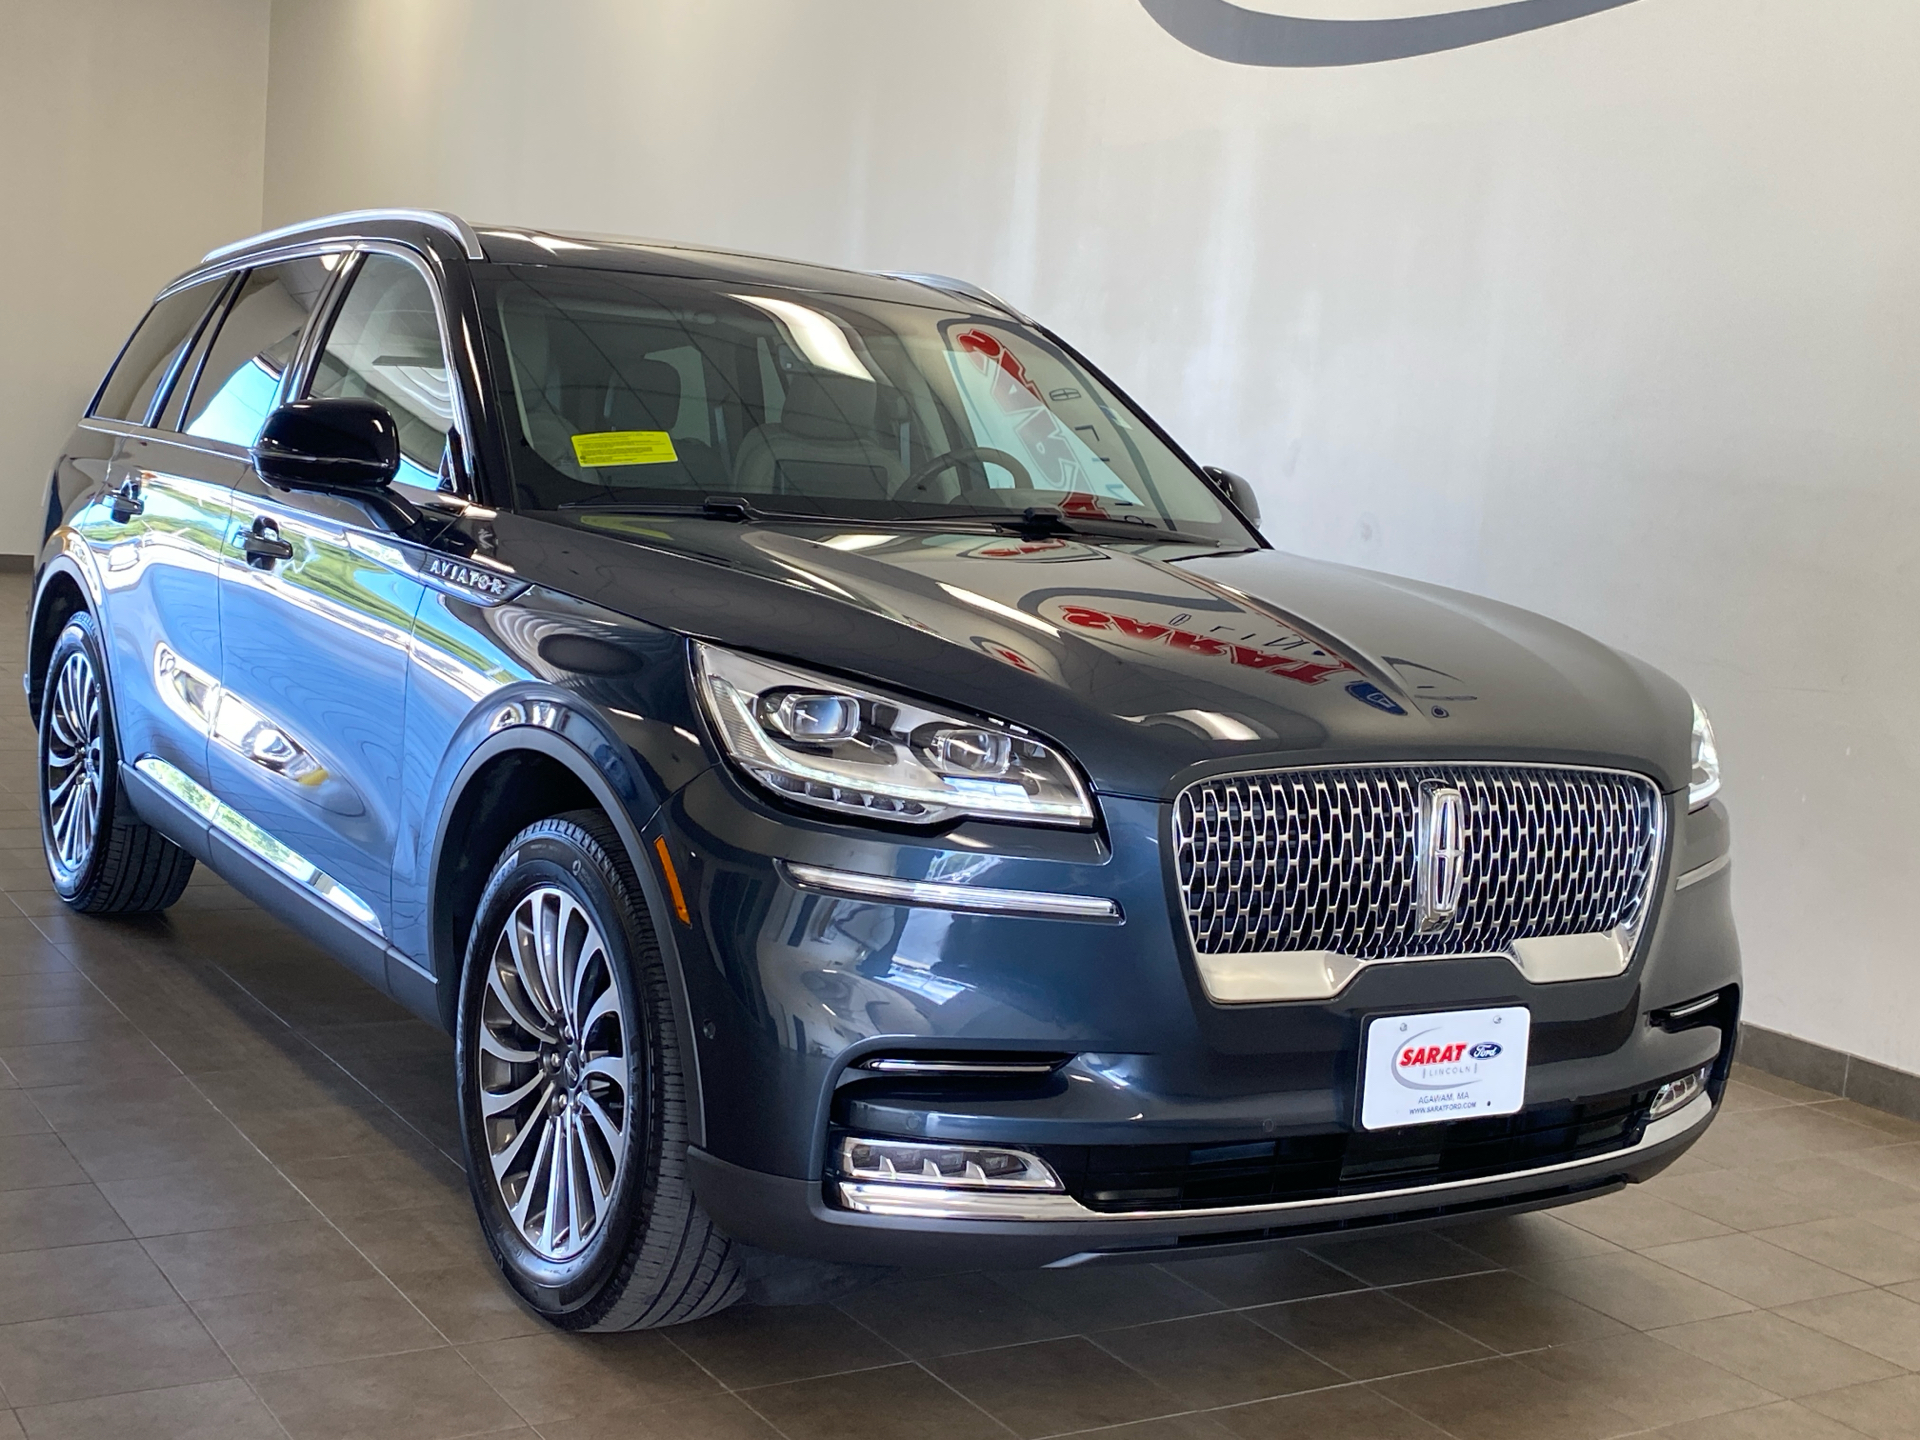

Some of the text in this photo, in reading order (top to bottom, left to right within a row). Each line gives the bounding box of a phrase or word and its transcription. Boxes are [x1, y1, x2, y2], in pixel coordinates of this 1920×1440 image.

[429, 559, 506, 595] AVIATOR
[1398, 1043, 1499, 1067] SARAT Ford
[1429, 1066, 1471, 1077] LINCOLN
[1456, 1091, 1470, 1100] MA
[1409, 1101, 1477, 1115] WWW.SARATFORD.COM
